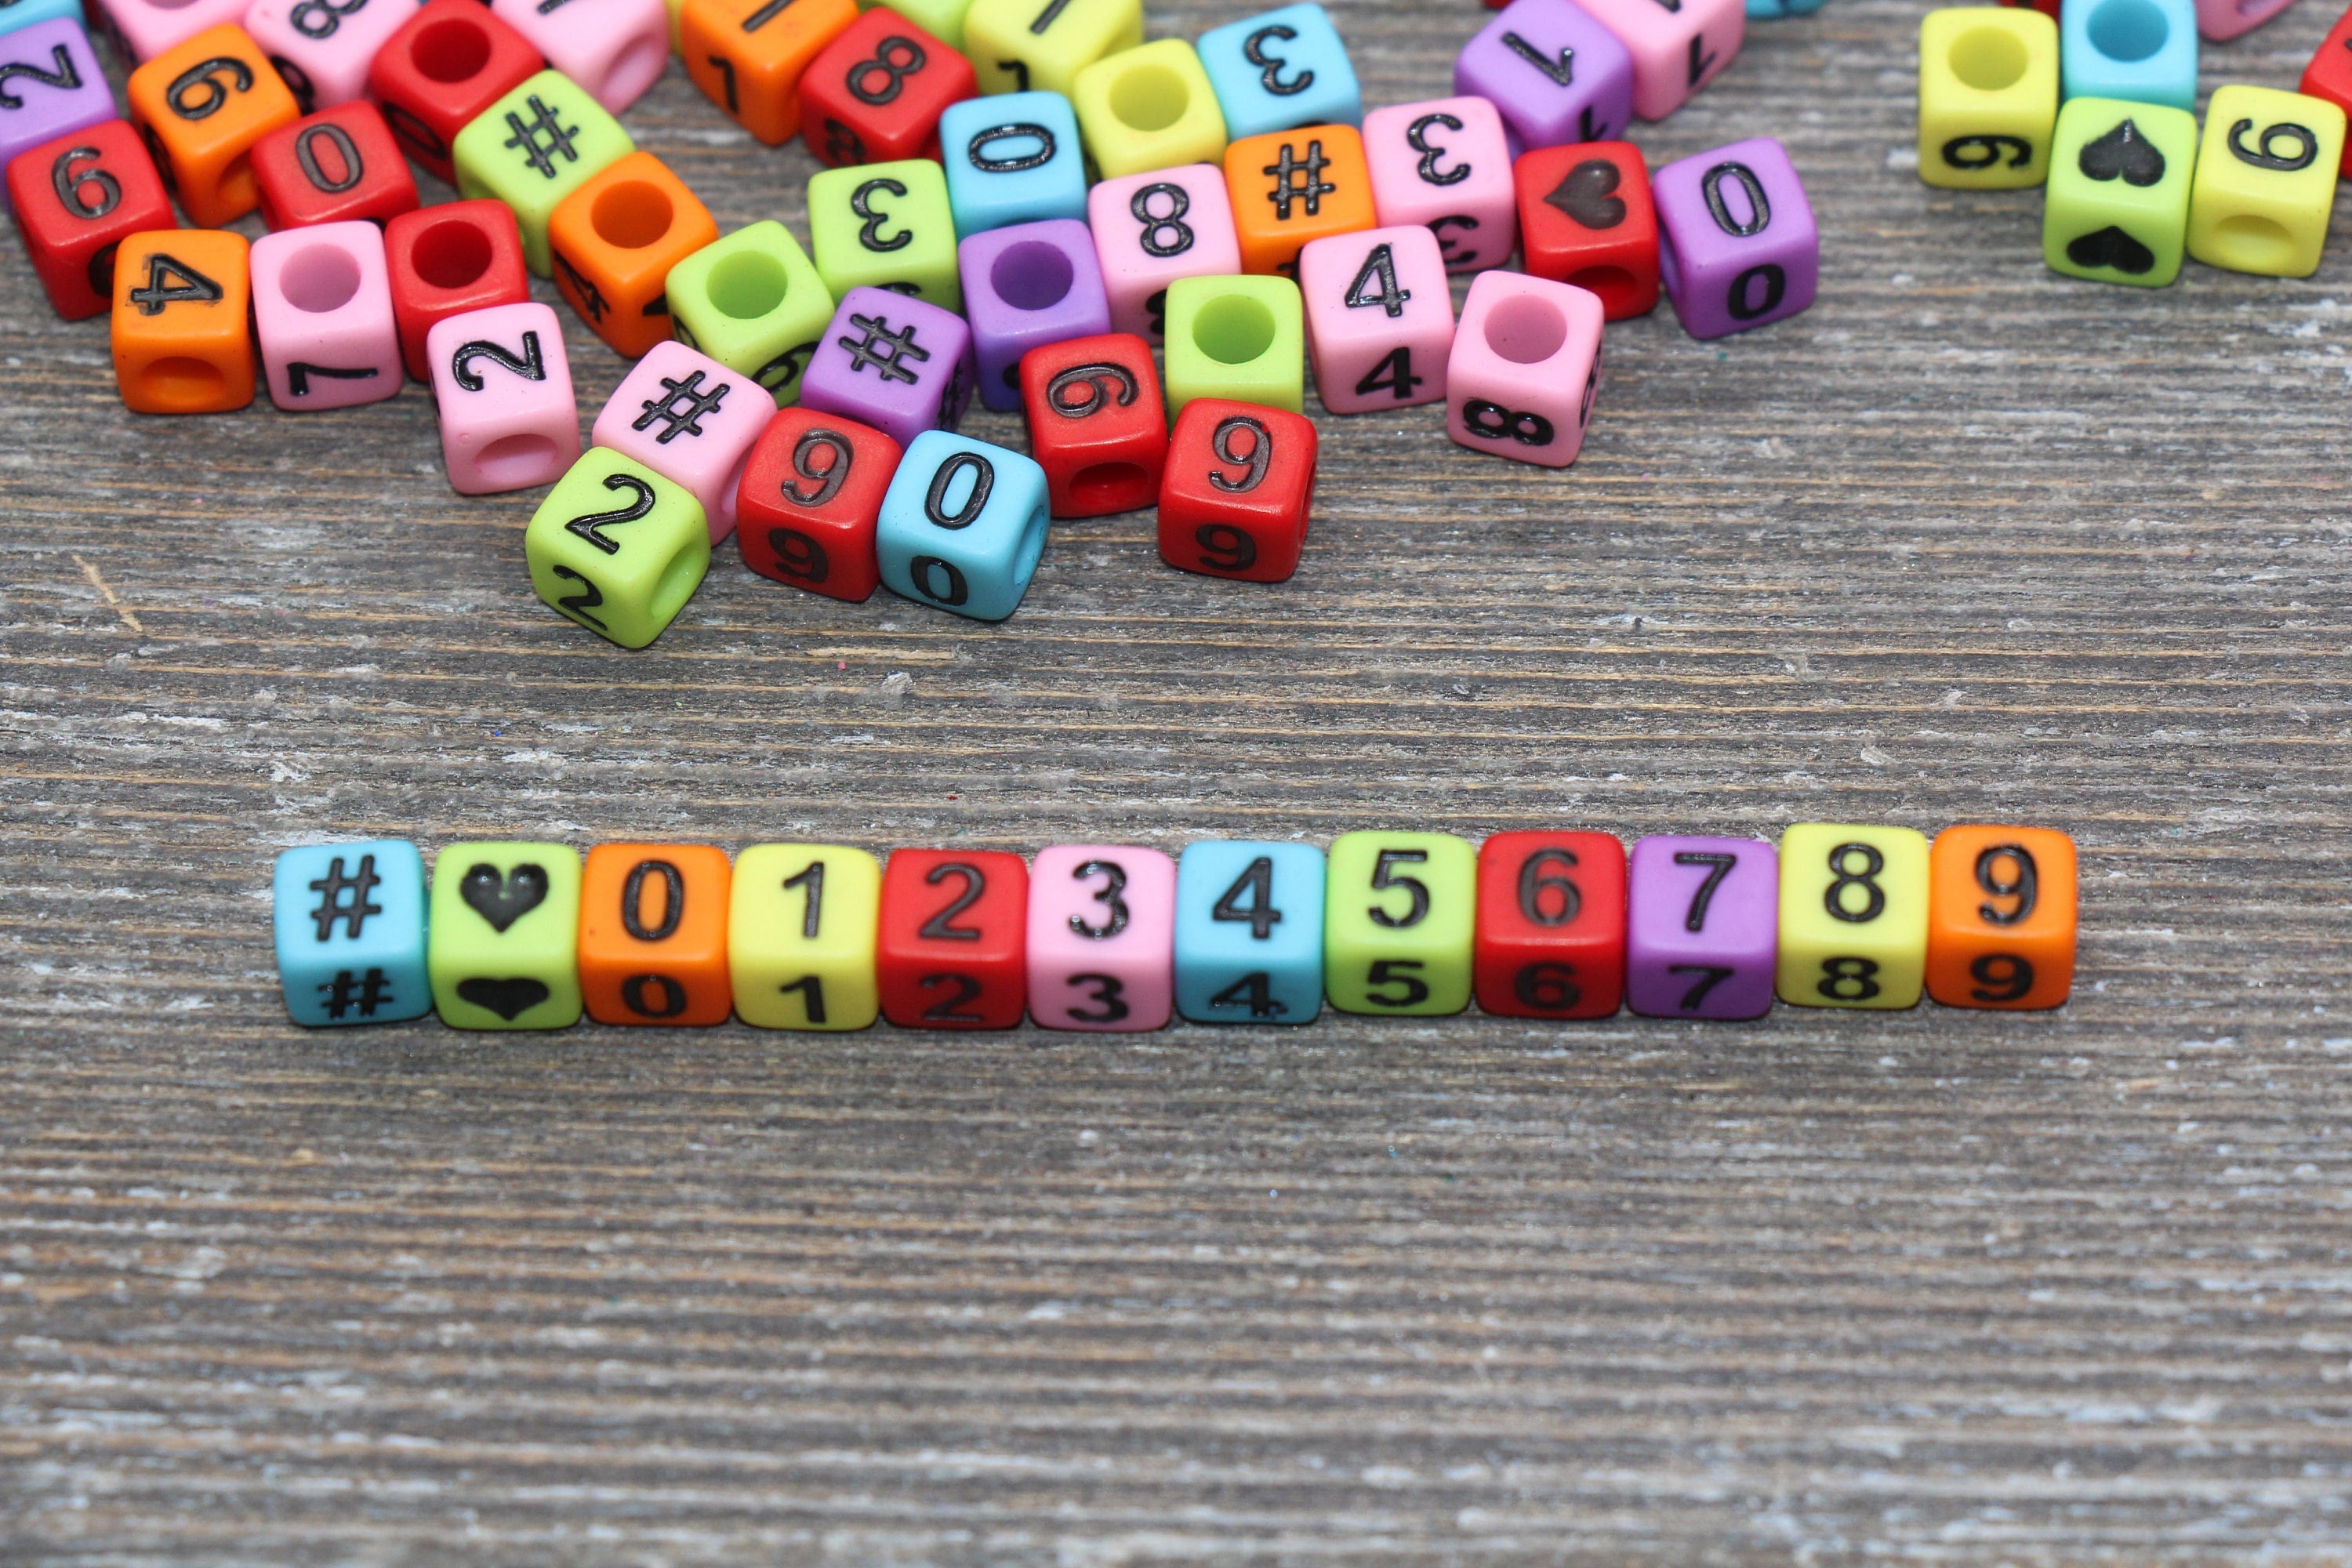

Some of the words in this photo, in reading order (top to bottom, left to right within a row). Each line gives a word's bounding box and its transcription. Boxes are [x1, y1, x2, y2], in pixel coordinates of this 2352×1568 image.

[0, 43, 83, 109] 2
[846, 35, 926, 106] 8
[1243, 24, 1315, 96] 3
[296, 123, 363, 194] 0
[504, 95, 579, 179] #
[969, 123, 1056, 172] 0
[1407, 113, 1471, 187] 3
[51, 146, 122, 220] 6
[851, 179, 913, 252] 3
[1263, 140, 1336, 220] #
[1700, 162, 1771, 237] 0
[1131, 182, 1194, 257] 8
[130, 252, 223, 316] 4
[1345, 243, 1410, 318] 4
[1728, 264, 1785, 321] 0
[452, 330, 546, 391] 2
[838, 313, 931, 385] #
[1355, 347, 1422, 399] 4
[632, 370, 730, 444] #
[1463, 399, 1555, 446] 8
[782, 428, 854, 507] 9
[924, 451, 995, 530] 0
[1207, 416, 1272, 493] 9
[564, 474, 656, 555] 2
[1195, 524, 1257, 571] 9
[769, 528, 829, 584] 9
[910, 555, 968, 606] 0
[552, 564, 608, 632] 2
[310, 855, 381, 941] #
[620, 859, 684, 942] 0
[783, 862, 824, 938] 1
[918, 862, 985, 941] 2
[1068, 859, 1130, 939] 3
[1212, 856, 1282, 939] 4
[1368, 848, 1430, 928] 5
[1517, 847, 1580, 927] 6
[1674, 852, 1737, 931] 7
[1824, 842, 1886, 923] 8
[1976, 844, 2038, 925] 9
[318, 968, 393, 1018] #
[621, 974, 686, 1018] 0
[780, 975, 826, 1023] 1
[920, 973, 981, 1020] 2
[1066, 973, 1130, 1022] 3
[1208, 972, 1287, 1017] 4
[1366, 960, 1428, 1007] 5
[1514, 961, 1580, 1010] 6
[1669, 965, 1733, 1010] 7
[1817, 956, 1879, 1001] 8
[1969, 953, 2032, 1001] 9
